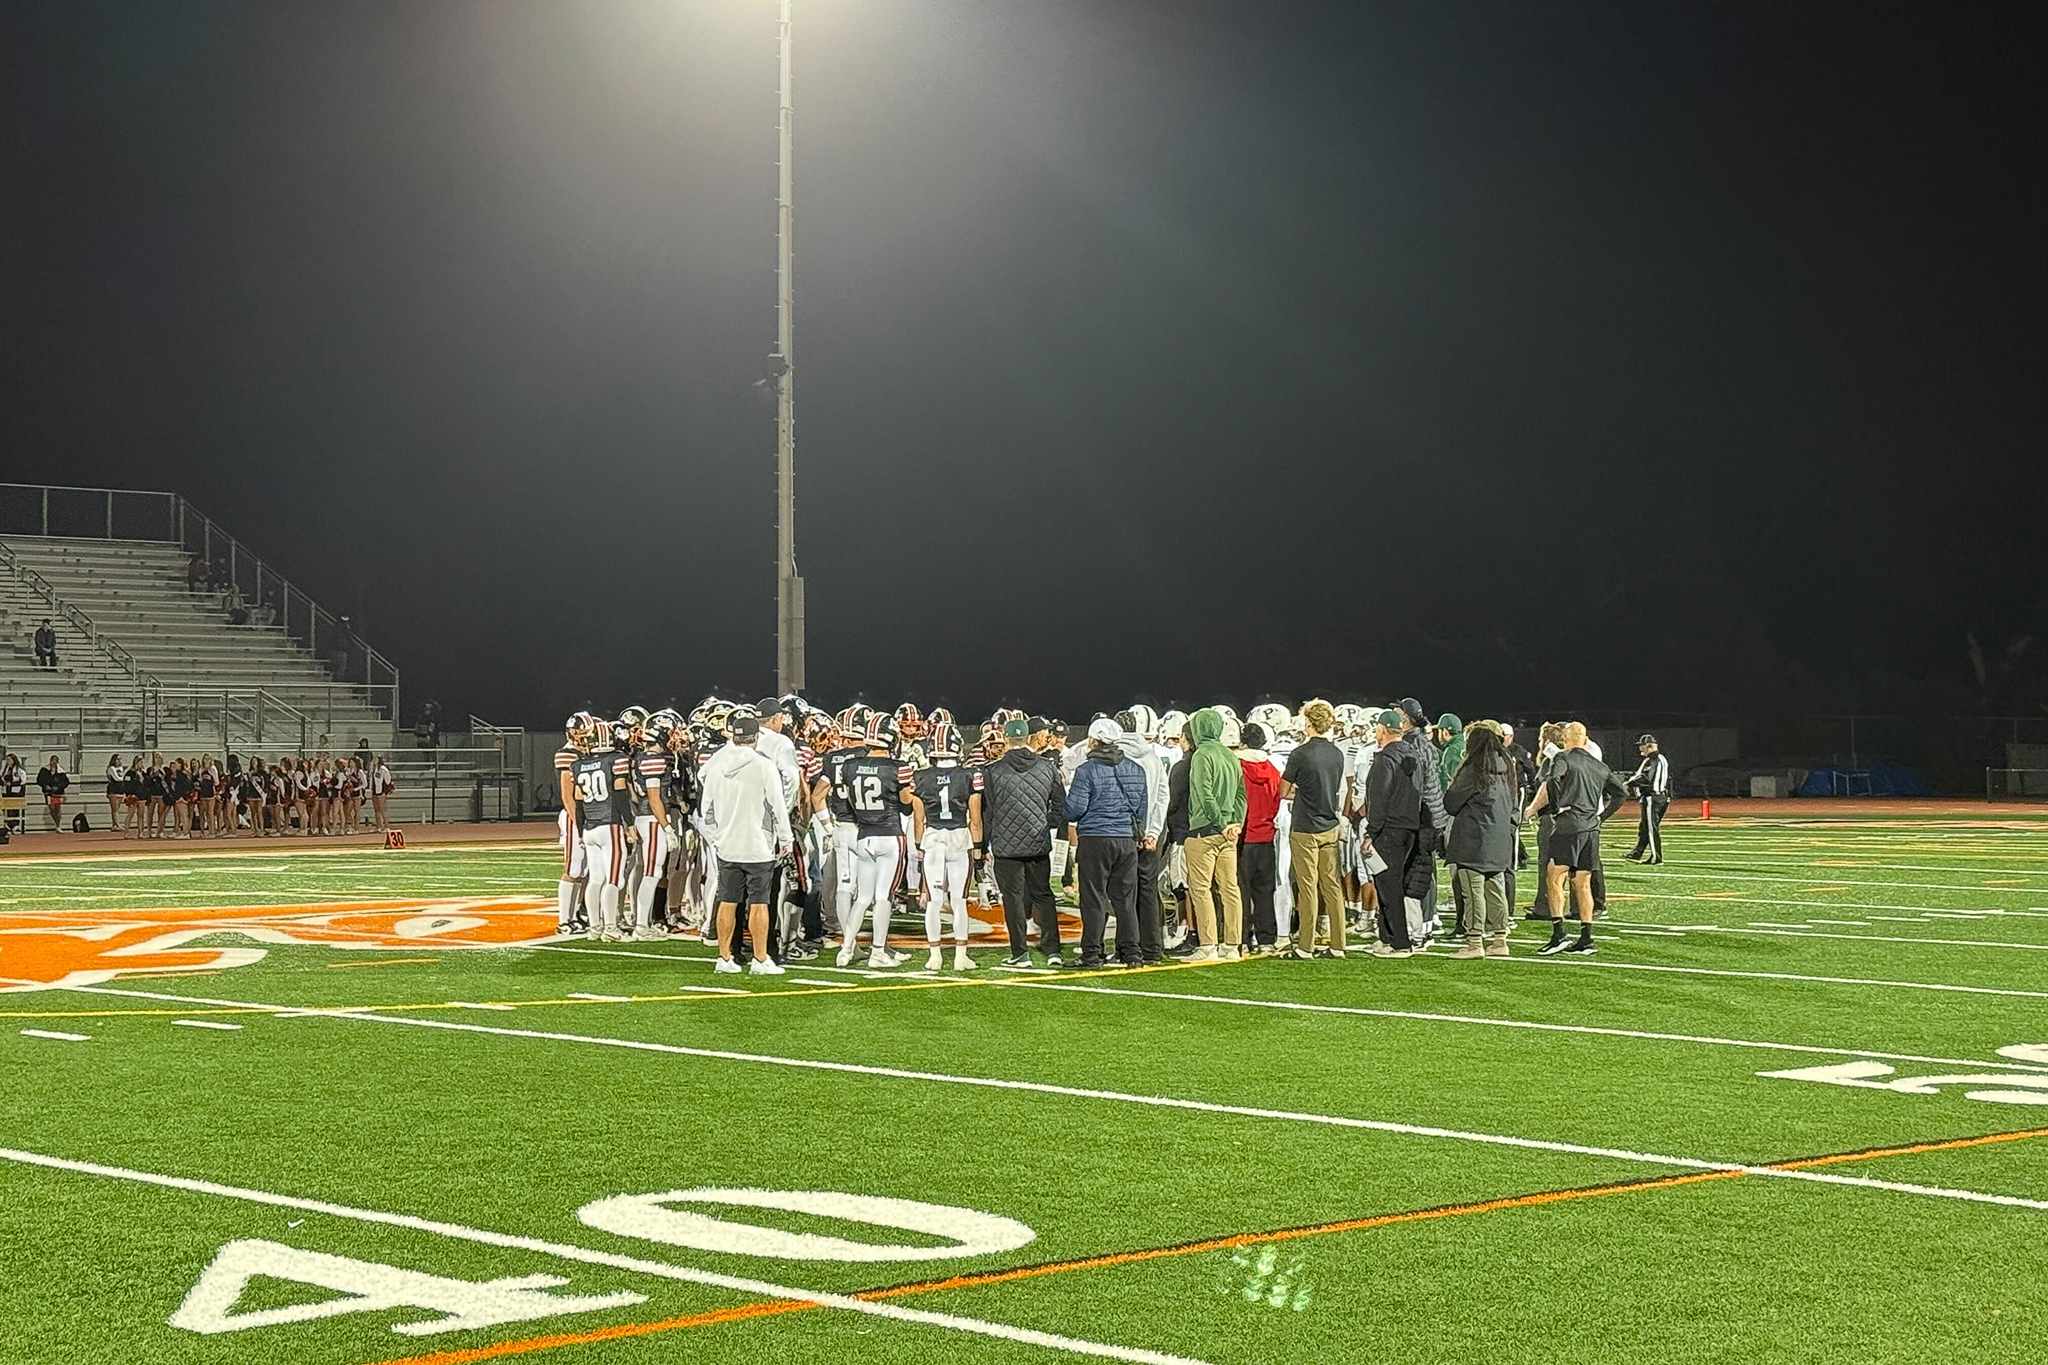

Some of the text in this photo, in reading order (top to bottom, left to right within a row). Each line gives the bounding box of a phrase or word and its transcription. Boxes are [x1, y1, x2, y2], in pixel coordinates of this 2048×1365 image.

[1263, 708, 1274, 721] P
[1347, 709, 1356, 719] P
[578, 770, 609, 803] 30
[853, 776, 885, 811] 12
[939, 786, 952, 819] 1
[391, 832, 404, 847] 30
